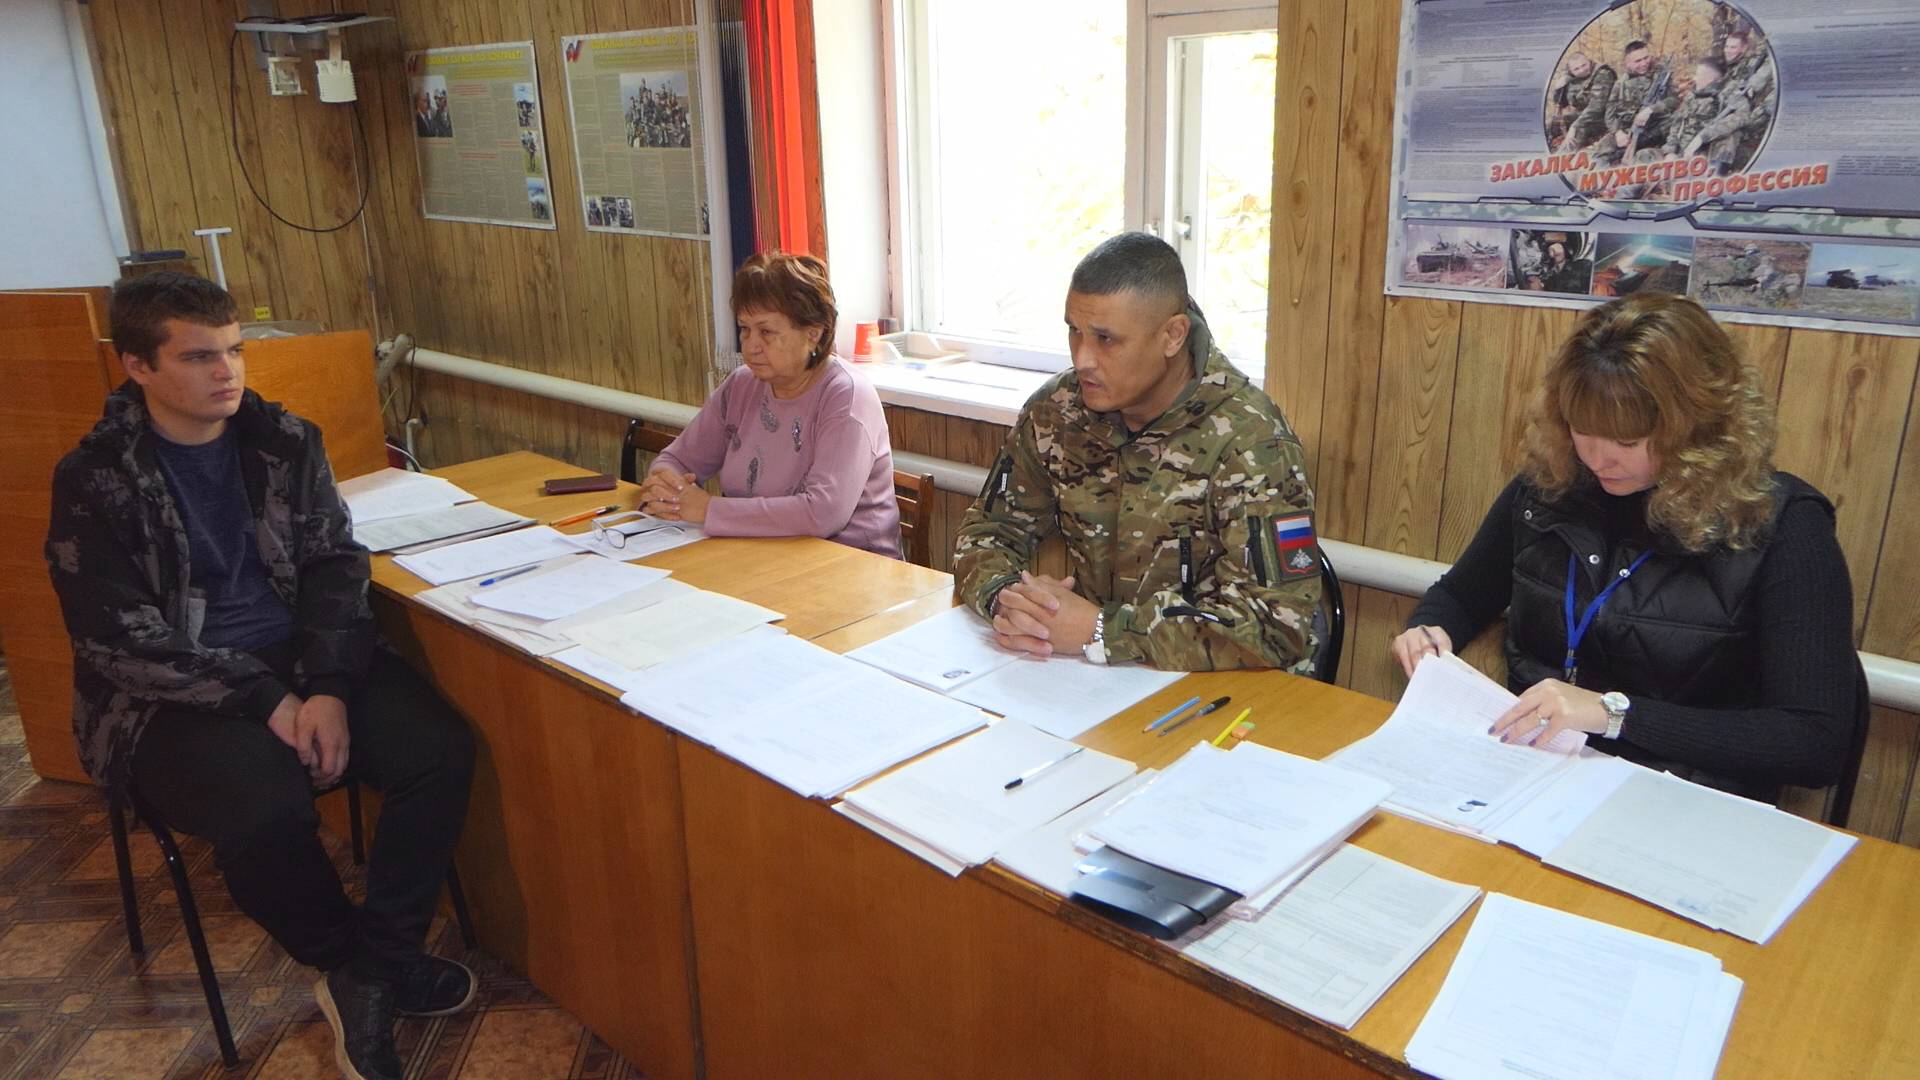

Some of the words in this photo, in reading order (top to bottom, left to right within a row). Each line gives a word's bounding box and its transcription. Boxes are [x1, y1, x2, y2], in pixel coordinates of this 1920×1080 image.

[1490, 153, 1596, 183] ЗАКАЛКА,
[1579, 156, 1715, 192] МУЖЕСТВО,
[1673, 165, 1829, 201] ПРОФЕССИЯ
